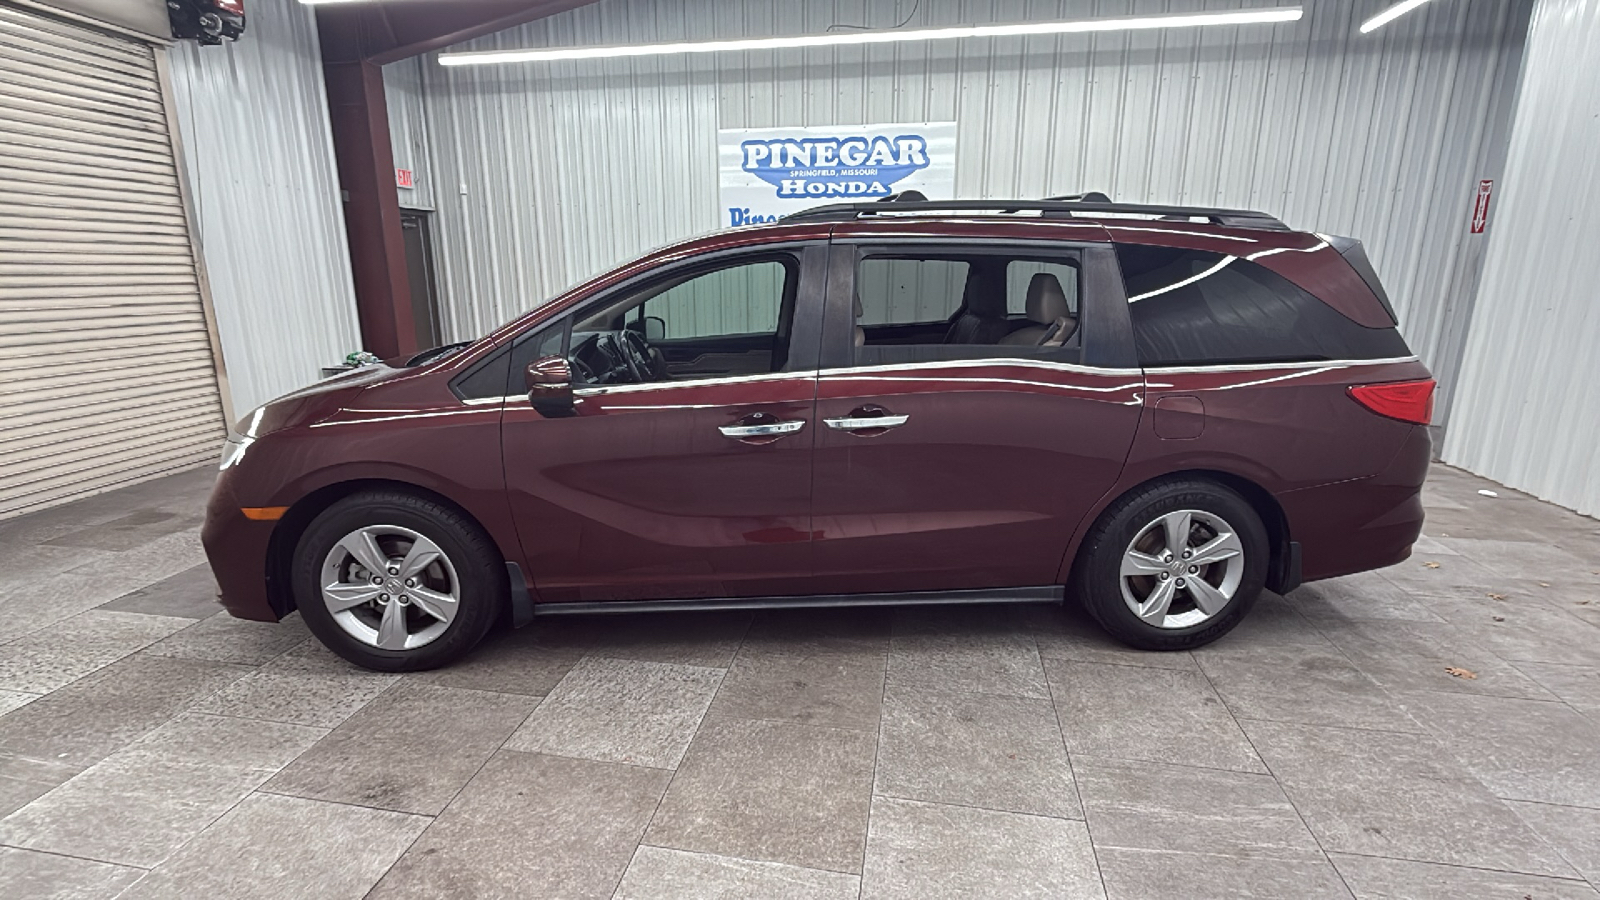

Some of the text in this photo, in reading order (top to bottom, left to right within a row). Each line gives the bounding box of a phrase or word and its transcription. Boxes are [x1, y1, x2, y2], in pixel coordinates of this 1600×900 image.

[744, 139, 926, 169] PINEGAR
[397, 169, 412, 187] EXIT
[790, 168, 878, 177] SPRINGFIELD, MISSOURI
[780, 179, 887, 194] HONDA
